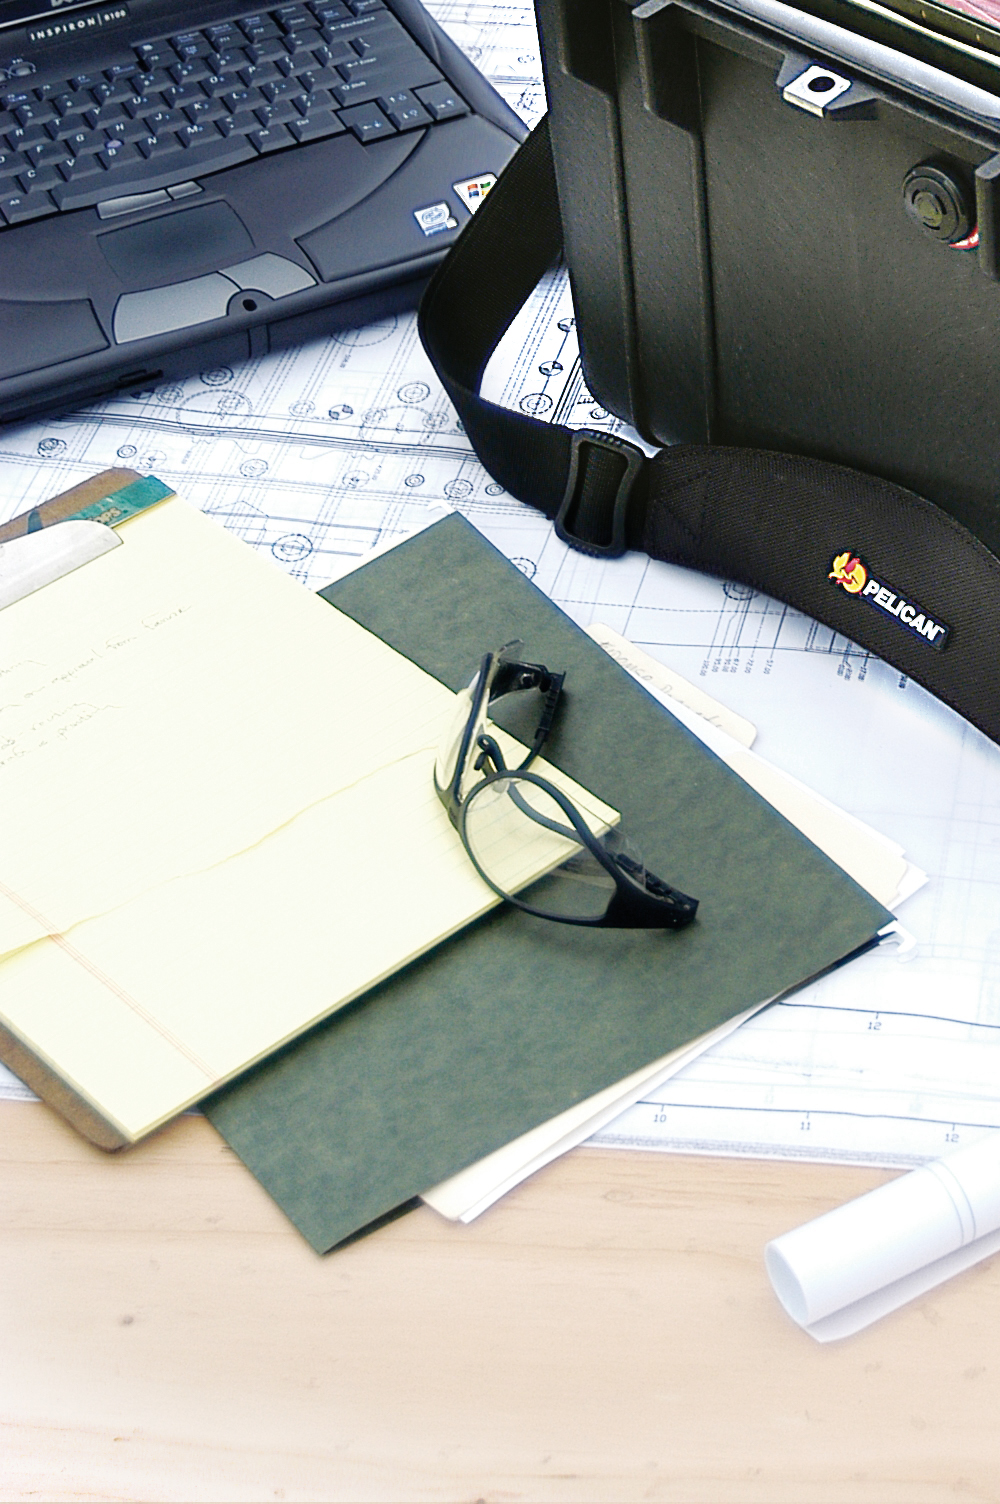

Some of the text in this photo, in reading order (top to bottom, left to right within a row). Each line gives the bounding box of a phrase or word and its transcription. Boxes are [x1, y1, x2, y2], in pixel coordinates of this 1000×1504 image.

[30, 17, 96, 41] INSPIRON
[132, 96, 141, 104] U
[194, 102, 202, 110] K
[115, 123, 124, 131] H
[186, 125, 198, 133] M
[76, 134, 84, 142] G
[147, 137, 157, 145] N
[66, 159, 76, 167] V
[27, 169, 36, 178] C
[862, 579, 938, 642] PELICAN
[867, 1020, 882, 1032] 12
[653, 1114, 667, 1123] 10
[800, 1122, 811, 1131] 11
[945, 1132, 959, 1143] 12
